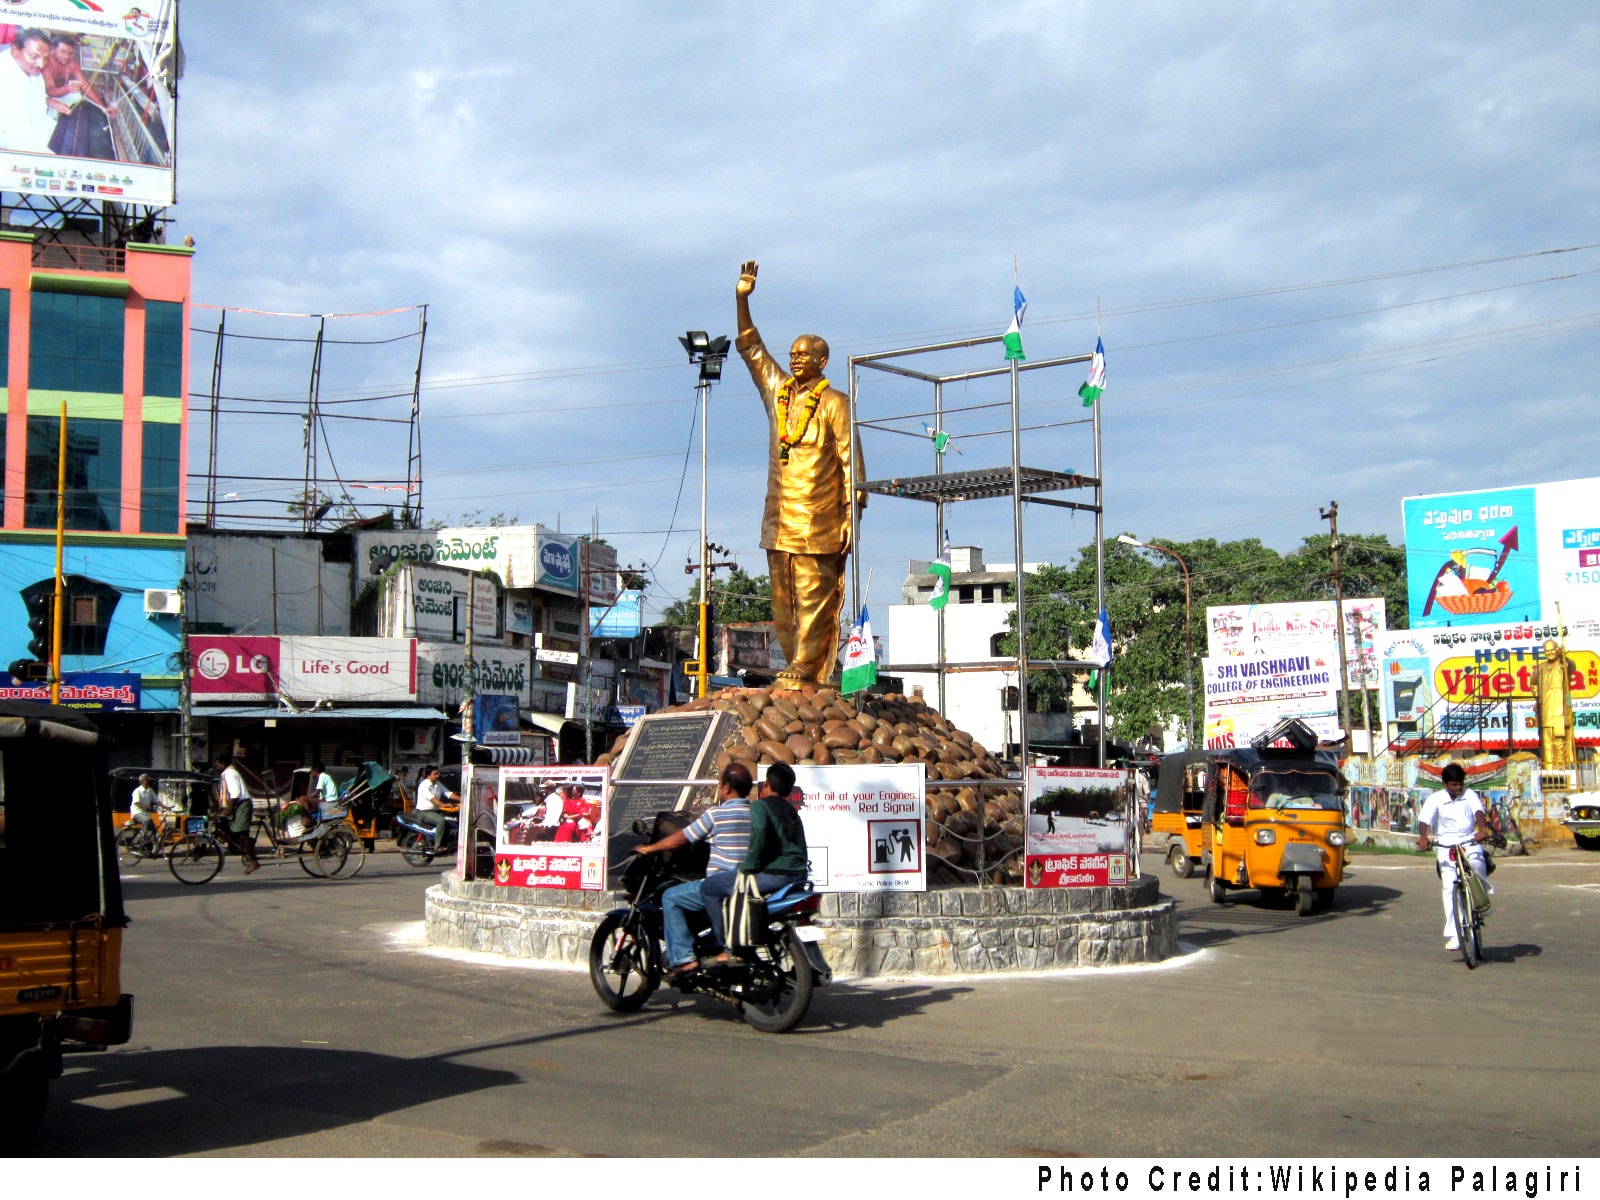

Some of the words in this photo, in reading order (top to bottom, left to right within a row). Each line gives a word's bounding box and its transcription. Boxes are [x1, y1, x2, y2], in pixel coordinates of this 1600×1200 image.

[436, 536, 499, 561] సిమెంట్
[418, 578, 452, 595] అంజని
[415, 595, 453, 616] సిమెంట్
[1504, 625, 1533, 641] విజేత
[1474, 645, 1548, 664] HOTE
[236, 655, 268, 674] LG
[302, 660, 341, 674] Life's
[347, 661, 389, 674] Good
[1217, 664, 1238, 679] SRI
[1240, 656, 1310, 677] VAISHNAVI
[1207, 679, 1243, 695] COLLEGE
[1245, 678, 1258, 690] OF
[1260, 671, 1330, 690] ENGINEERING
[61, 685, 135, 703] మెడికల్స్
[824, 791, 836, 801] oil
[839, 791, 849, 801] of
[853, 792, 876, 803] your
[829, 803, 851, 811] when
[858, 802, 879, 813] Red
[883, 801, 915, 815] Signal
[1045, 856, 1078, 872] ట్రాఫిక్
[1079, 855, 1108, 870] పోలీస్
